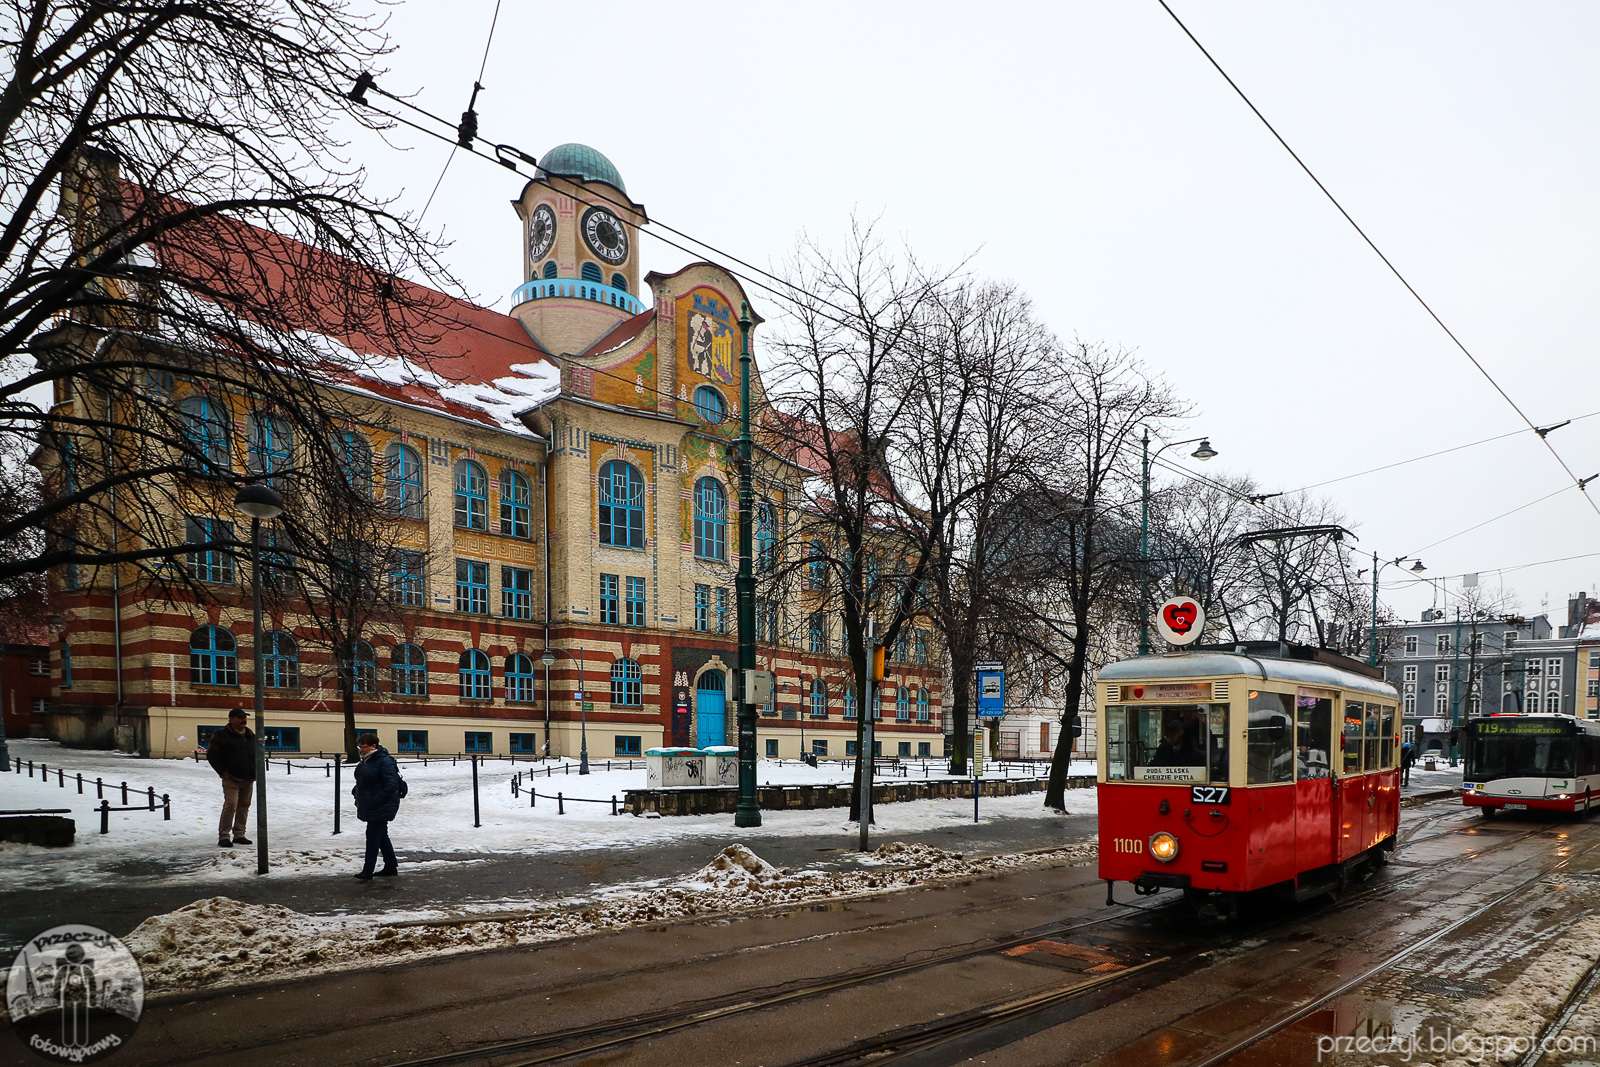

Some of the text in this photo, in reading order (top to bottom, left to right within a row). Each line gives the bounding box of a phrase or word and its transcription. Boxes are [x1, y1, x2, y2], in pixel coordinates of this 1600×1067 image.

[1477, 723, 1499, 733] T19
[1193, 787, 1228, 803] S27
[1113, 837, 1143, 854] 1100
